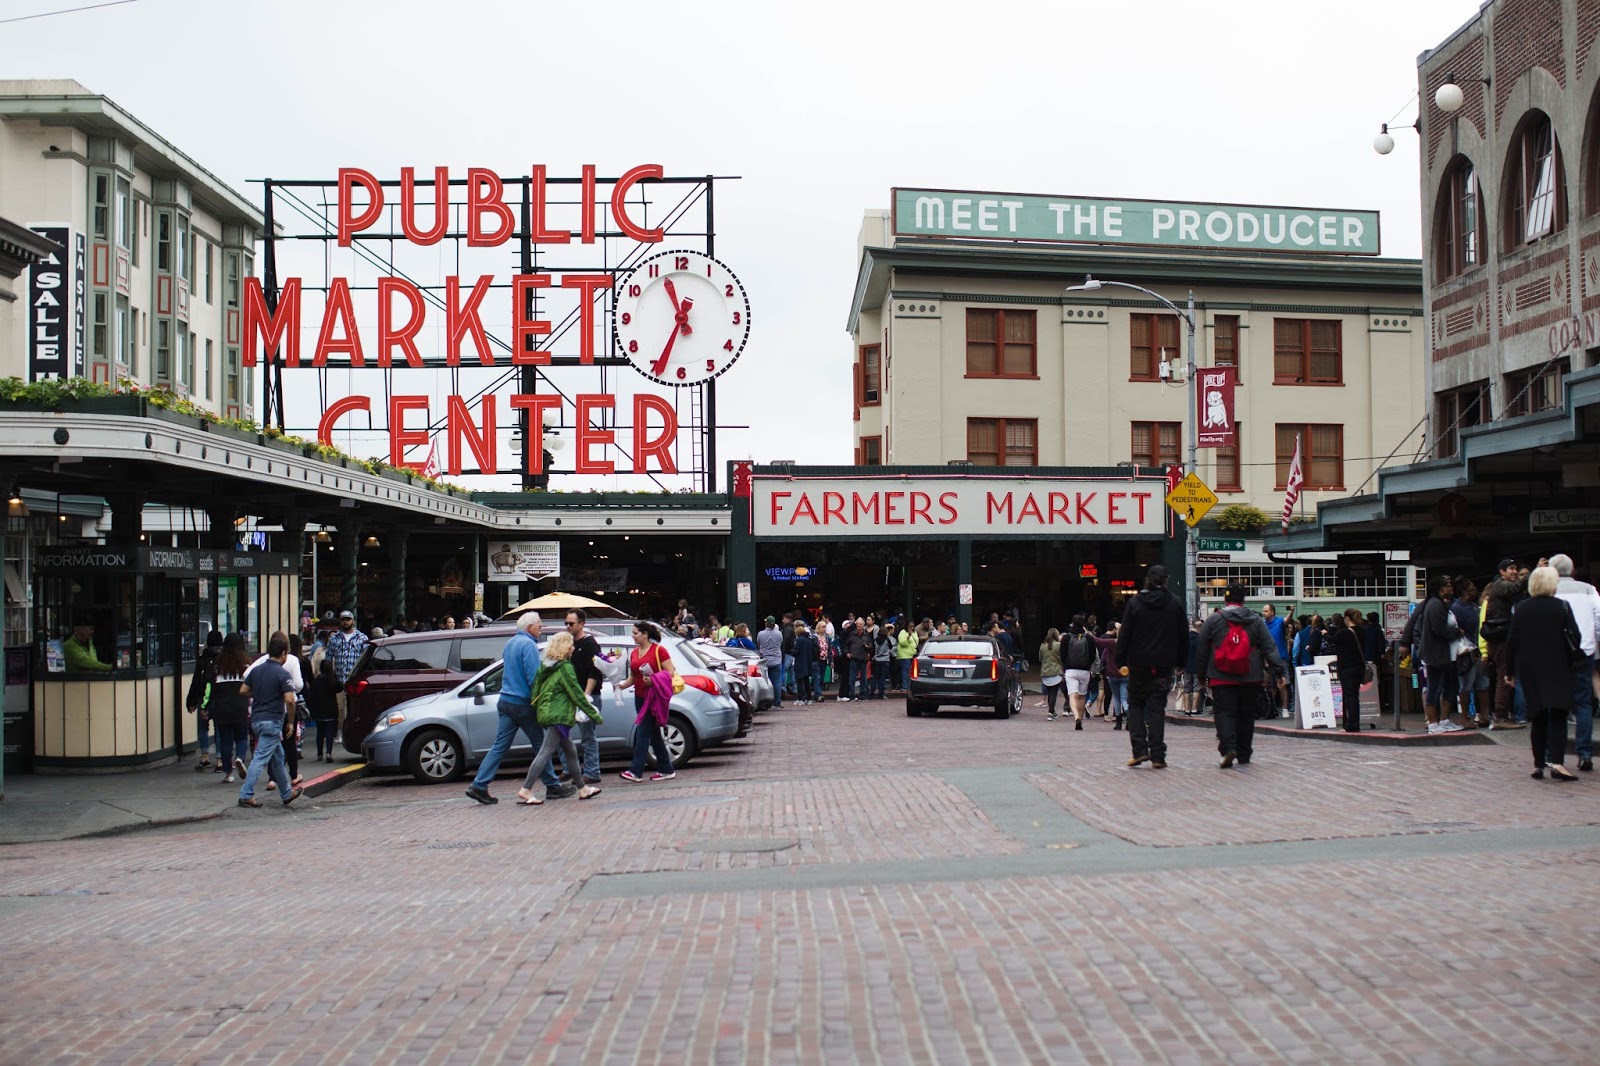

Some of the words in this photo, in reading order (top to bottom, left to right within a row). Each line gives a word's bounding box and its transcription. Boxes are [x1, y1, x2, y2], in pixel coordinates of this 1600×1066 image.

[338, 164, 664, 247] PUBLIC
[915, 197, 1023, 232] MEET
[1049, 203, 1123, 237] THE
[1152, 208, 1364, 247] PRODUCER
[77, 236, 84, 270] LA
[675, 256, 689, 270] 12
[649, 264, 659, 278] 11
[707, 264, 712, 277] 1
[629, 284, 641, 297] 10
[725, 284, 734, 297] 2
[34, 271, 61, 360] SALLE
[76, 279, 84, 365] SALLE
[243, 274, 614, 367] MARKET
[621, 312, 631, 325] 9
[732, 311, 741, 325] 3
[1549, 311, 1600, 356] CORN
[628, 339, 638, 353] 8
[723, 339, 734, 352] 4
[706, 359, 715, 372] 5
[676, 367, 686, 379] 6
[1205, 375, 1216, 385] PIKE
[317, 394, 678, 476] CENTER
[1183, 481, 1201, 489] YIELD
[1171, 496, 1212, 504] PEDESTRIANS
[771, 491, 958, 525] FARMERS
[986, 491, 1152, 525] MARKET
[1536, 512, 1555, 524] The
[517, 544, 534, 552] YOUR
[1200, 539, 1219, 549] Pike
[38, 554, 126, 566] INFORMATION
[149, 550, 186, 568] INFORMATION
[765, 567, 817, 576] VIEWPNT
[575, 583, 608, 591] Salmon
